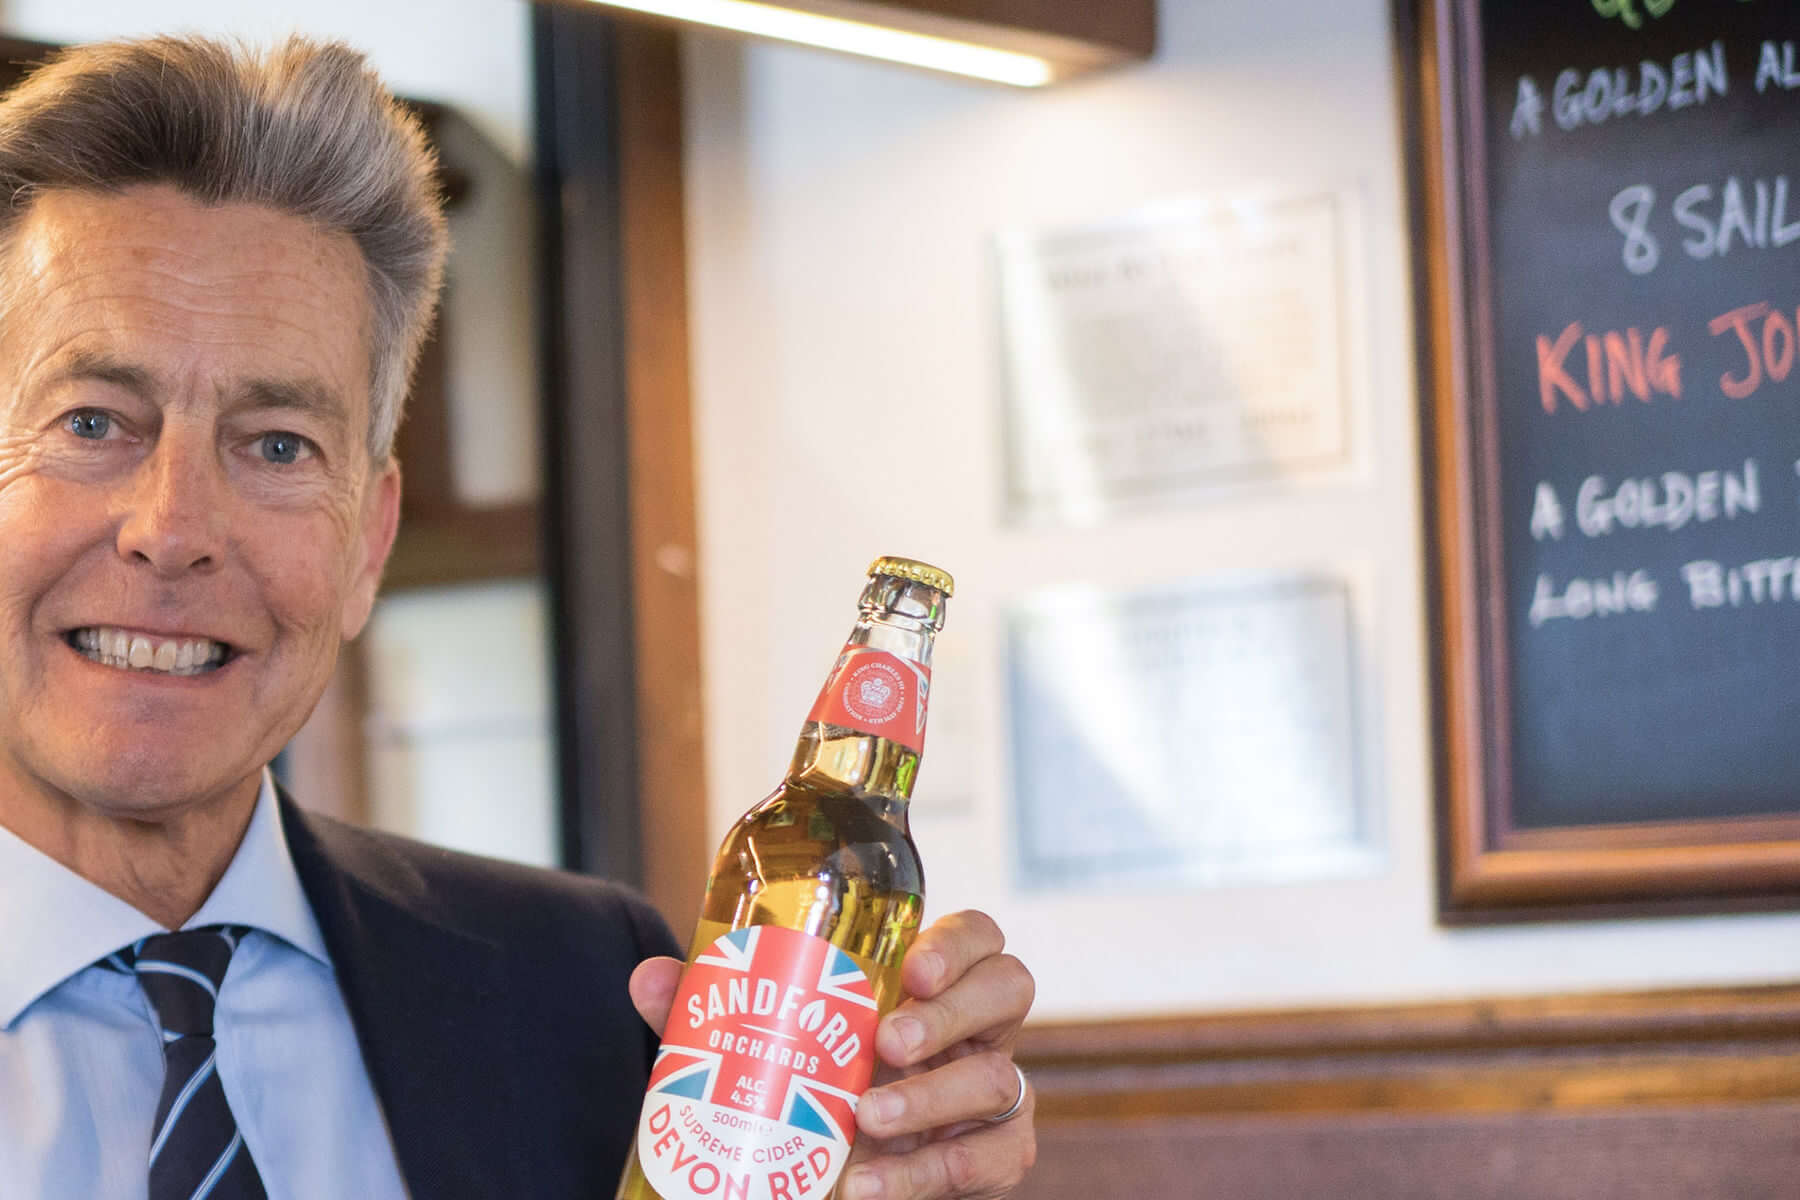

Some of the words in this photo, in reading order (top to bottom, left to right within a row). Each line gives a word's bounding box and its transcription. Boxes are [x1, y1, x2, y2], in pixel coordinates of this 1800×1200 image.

[1509, 75, 1543, 137] A
[1553, 40, 1728, 130] GOLDEN
[1608, 184, 1660, 274] 8
[1536, 320, 1681, 414] KING
[1708, 302, 1800, 399] JO
[1530, 481, 1563, 540] A
[1576, 457, 1759, 537] GOLDEN
[1529, 573, 1659, 628] LONG
[688, 977, 860, 1068] SANDFORD
[708, 1029, 819, 1075] ORCHARDS
[679, 1104, 742, 1162] SUPREME
[753, 1135, 805, 1164] CIDER
